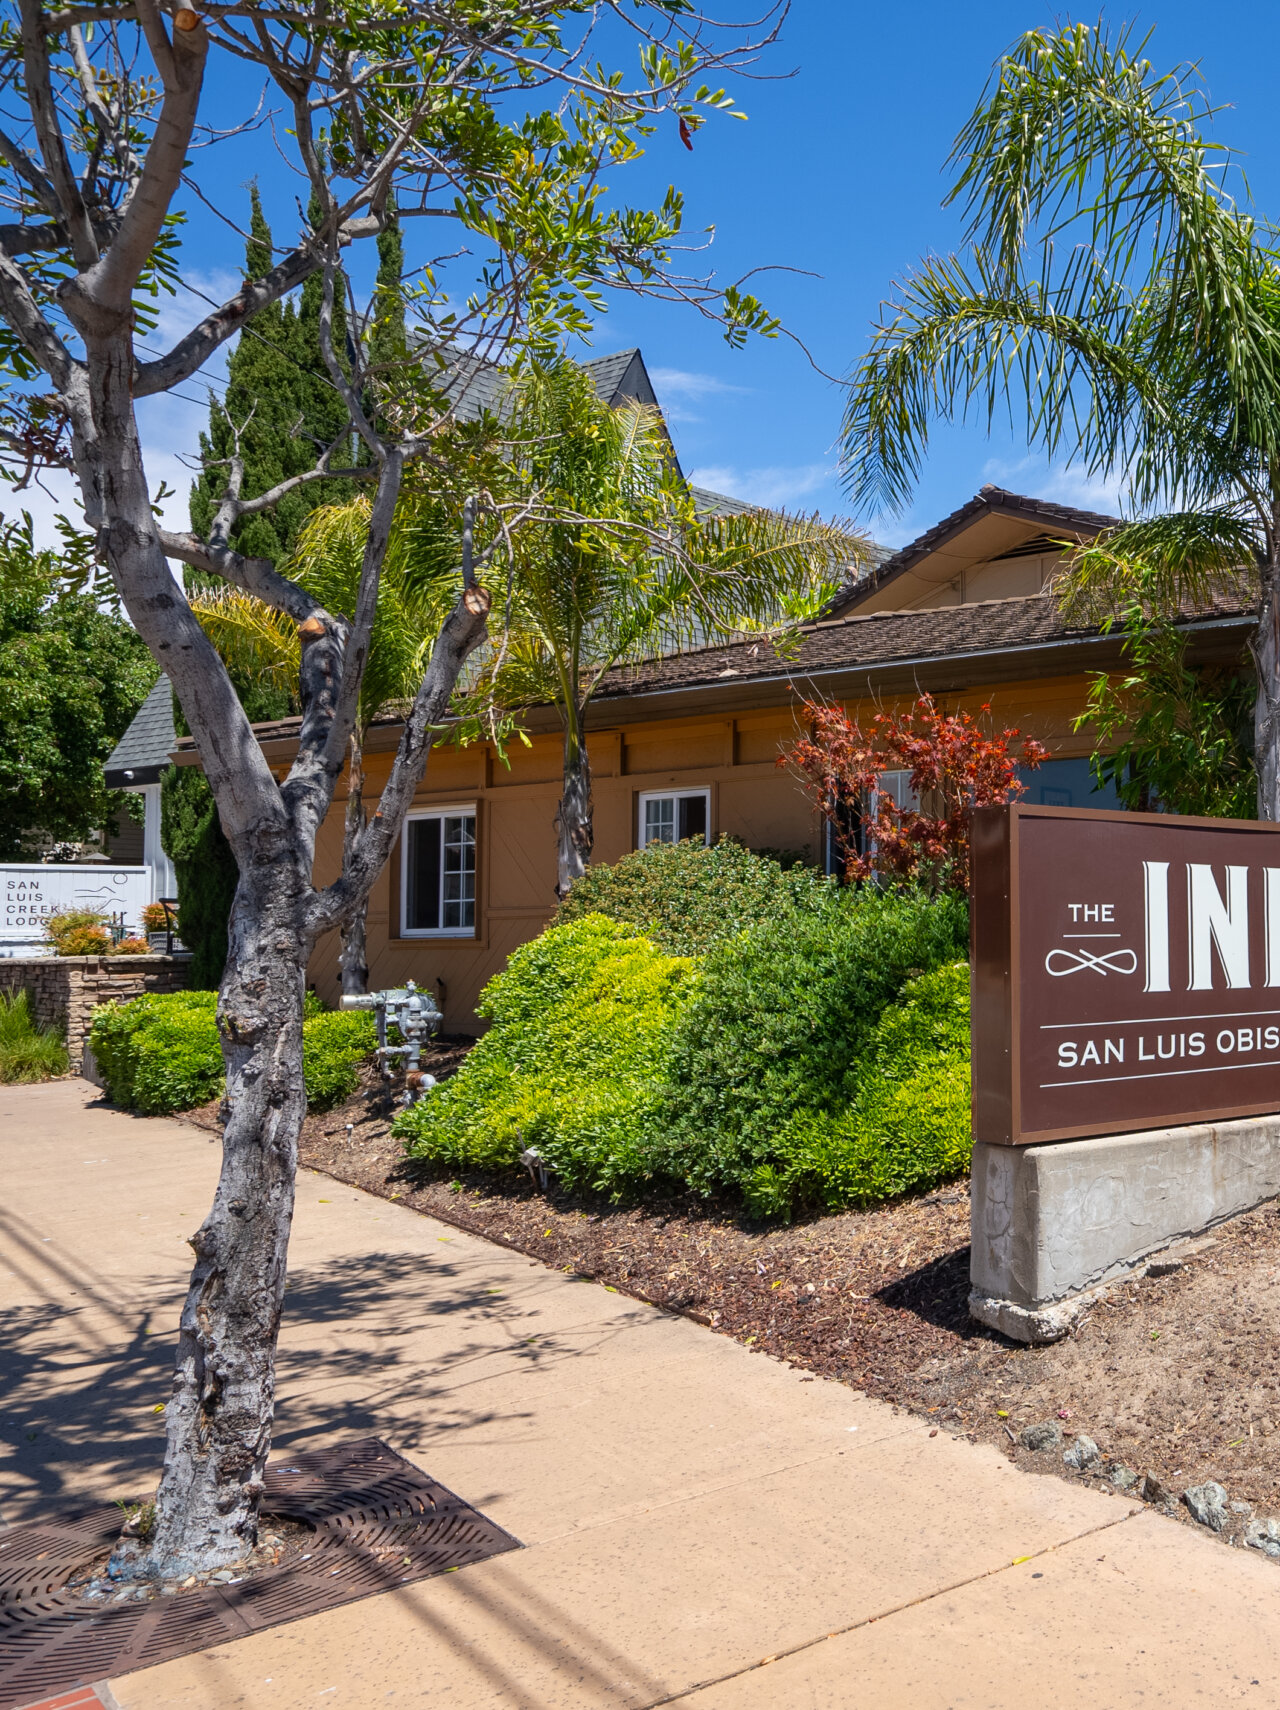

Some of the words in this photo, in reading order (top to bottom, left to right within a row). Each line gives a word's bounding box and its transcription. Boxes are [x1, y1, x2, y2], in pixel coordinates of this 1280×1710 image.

[7, 880, 40, 890] SAN
[7, 893, 44, 902] LUIS
[6, 905, 58, 914] CREEK
[1068, 903, 1115, 922] THE
[6, 917, 49, 926] LODG
[1058, 1038, 1124, 1067] SAN
[1139, 1032, 1205, 1060] LUIS
